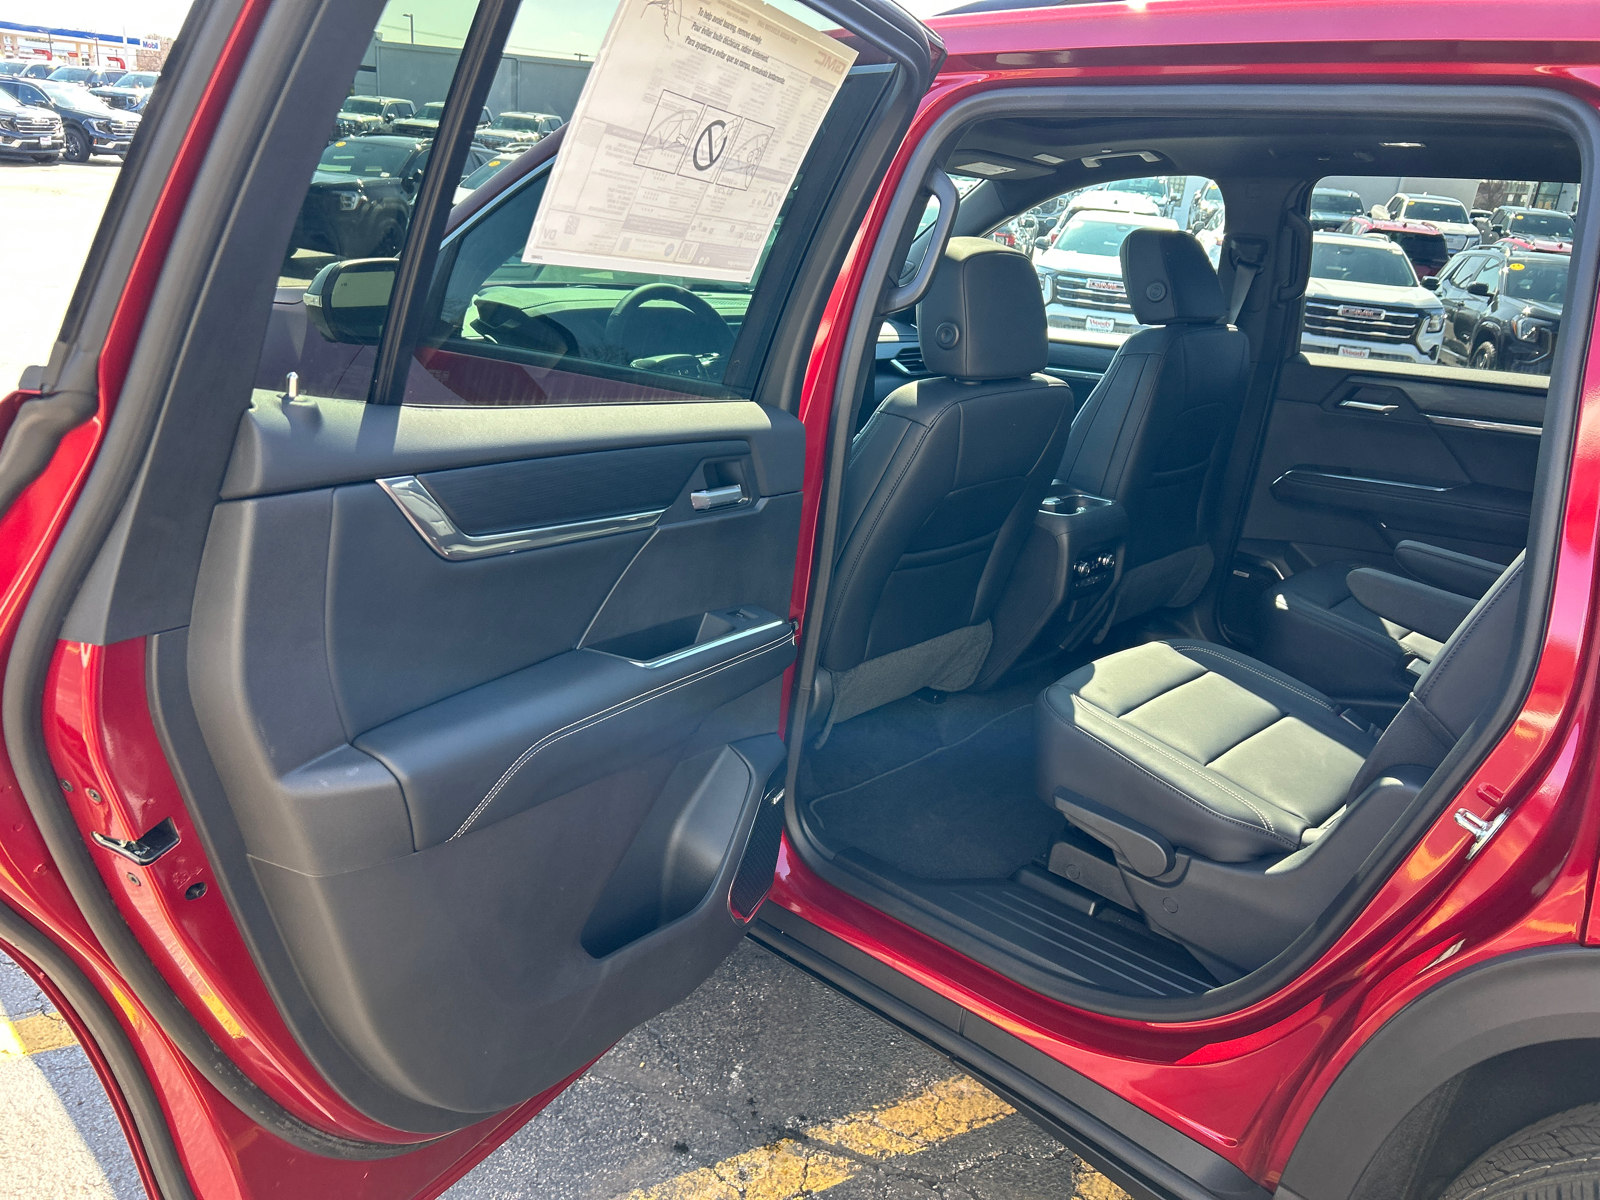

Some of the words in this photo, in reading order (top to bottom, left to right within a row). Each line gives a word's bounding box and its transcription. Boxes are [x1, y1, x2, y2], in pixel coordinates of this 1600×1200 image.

[691, 21, 702, 32] Pour
[712, 31, 724, 42] toute
[698, 7, 704, 17] To
[703, 10, 713, 21] help
[712, 15, 724, 26] avoid
[737, 27, 751, 39] remove
[143, 41, 158, 50] Mobil
[684, 35, 695, 47] Para
[715, 48, 727, 60] evitar
[726, 54, 735, 63] que
